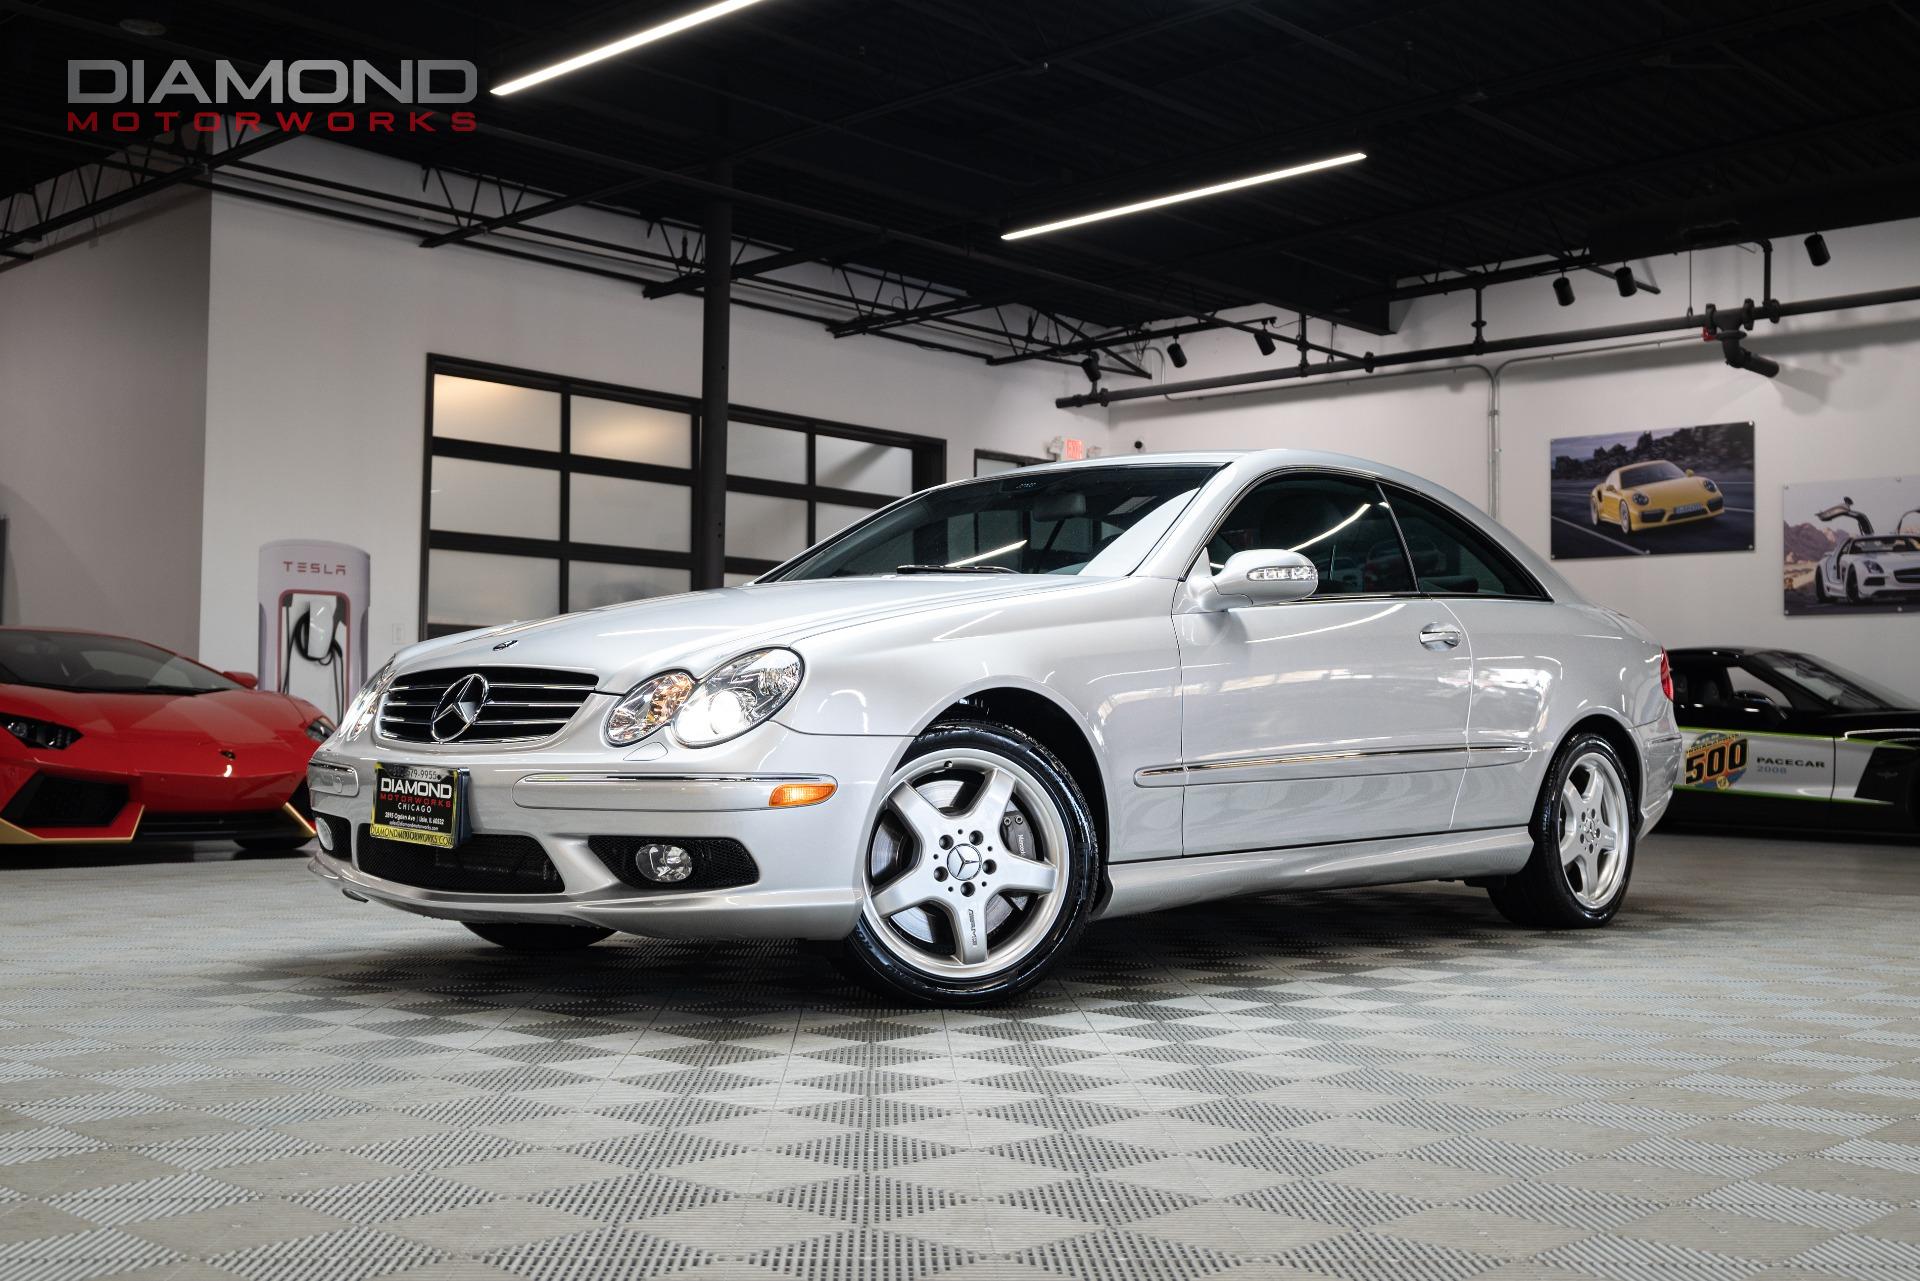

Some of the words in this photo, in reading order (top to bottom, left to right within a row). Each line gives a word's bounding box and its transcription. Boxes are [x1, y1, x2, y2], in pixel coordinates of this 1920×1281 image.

[283, 561, 346, 575] TESLA
[1685, 739, 1747, 785] 500
[1756, 756, 1825, 768] PACECAR
[380, 777, 452, 799] DIAMOND
[380, 793, 452, 808] MOTORWORKS
[397, 802, 432, 813] CHICAGO
